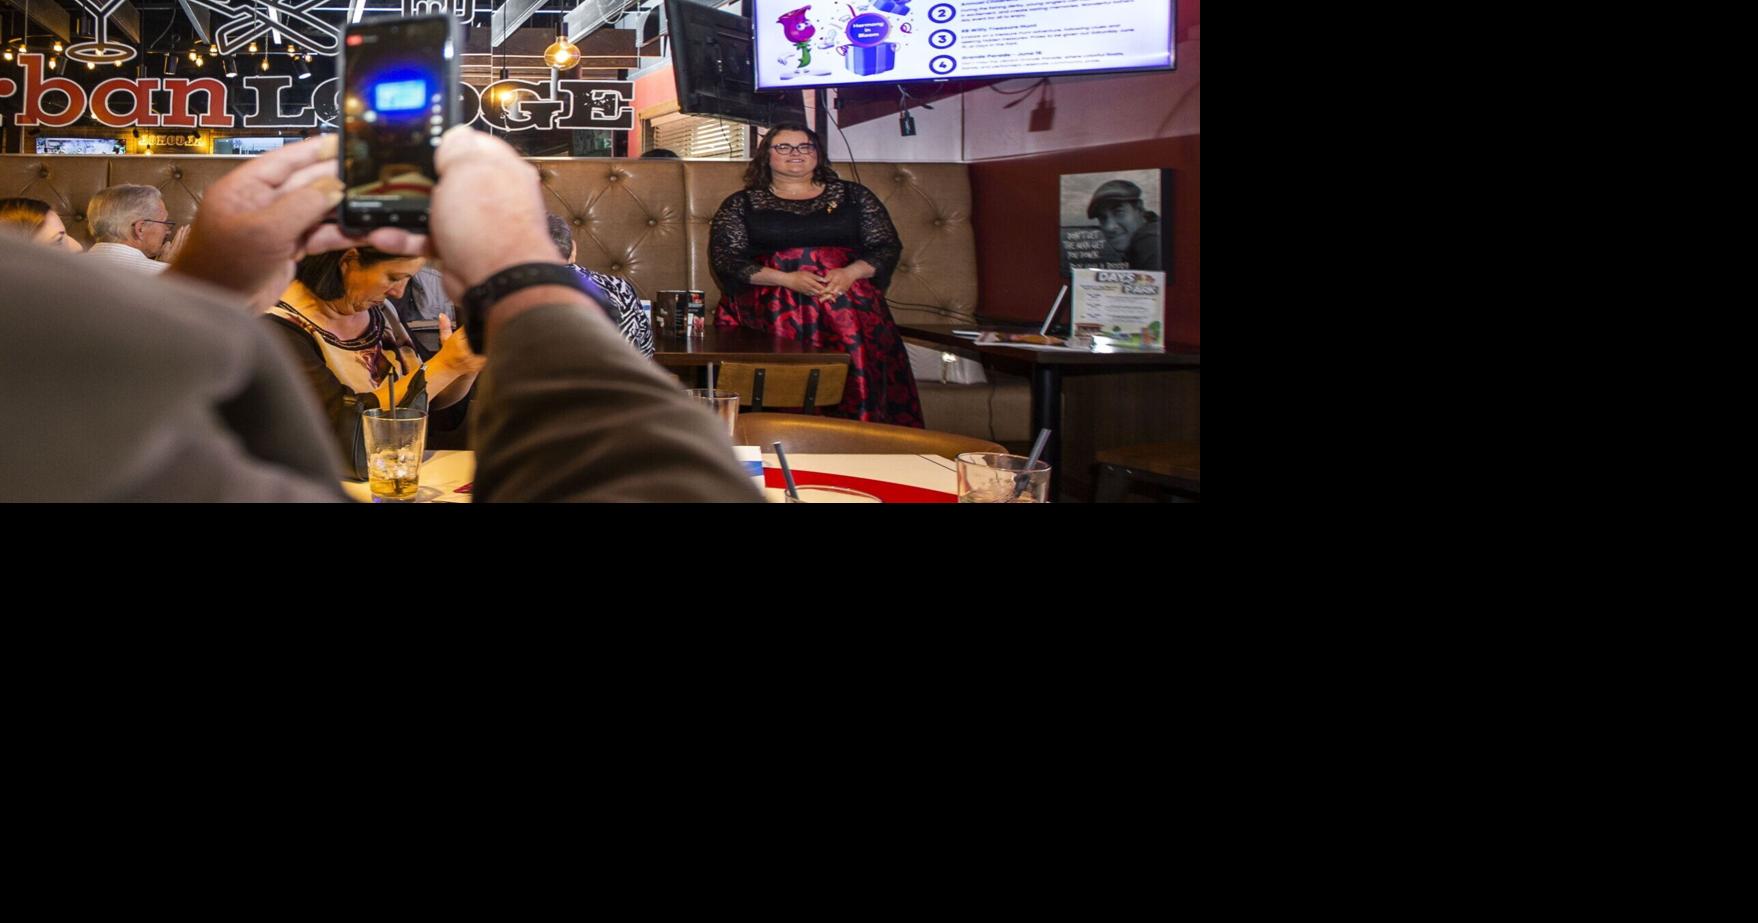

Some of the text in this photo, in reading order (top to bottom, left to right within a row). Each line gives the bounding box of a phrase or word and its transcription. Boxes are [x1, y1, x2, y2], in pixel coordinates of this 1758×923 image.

[938, 9, 946, 17] 2
[938, 35, 947, 43] 3
[243, 75, 635, 132] LGE
[1096, 271, 1136, 283] DAYS
